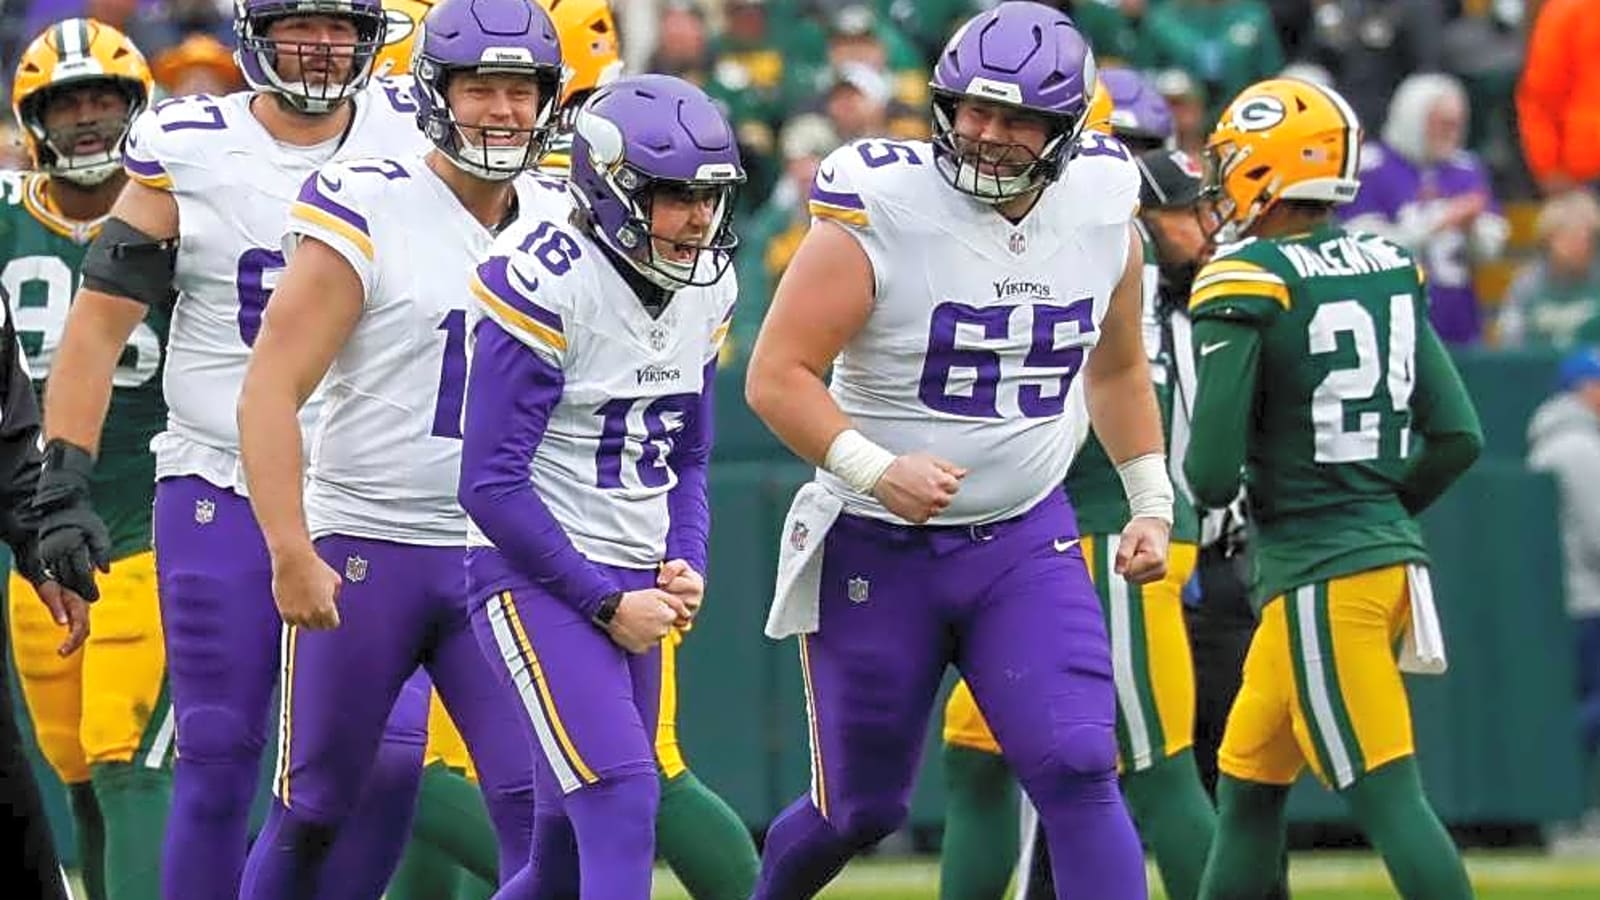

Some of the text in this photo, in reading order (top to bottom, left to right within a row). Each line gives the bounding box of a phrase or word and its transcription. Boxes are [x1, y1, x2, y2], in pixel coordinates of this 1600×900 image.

[517, 221, 582, 276] 16
[918, 298, 1095, 418] 65
[1308, 294, 1416, 463] 24
[593, 394, 684, 488] 16
